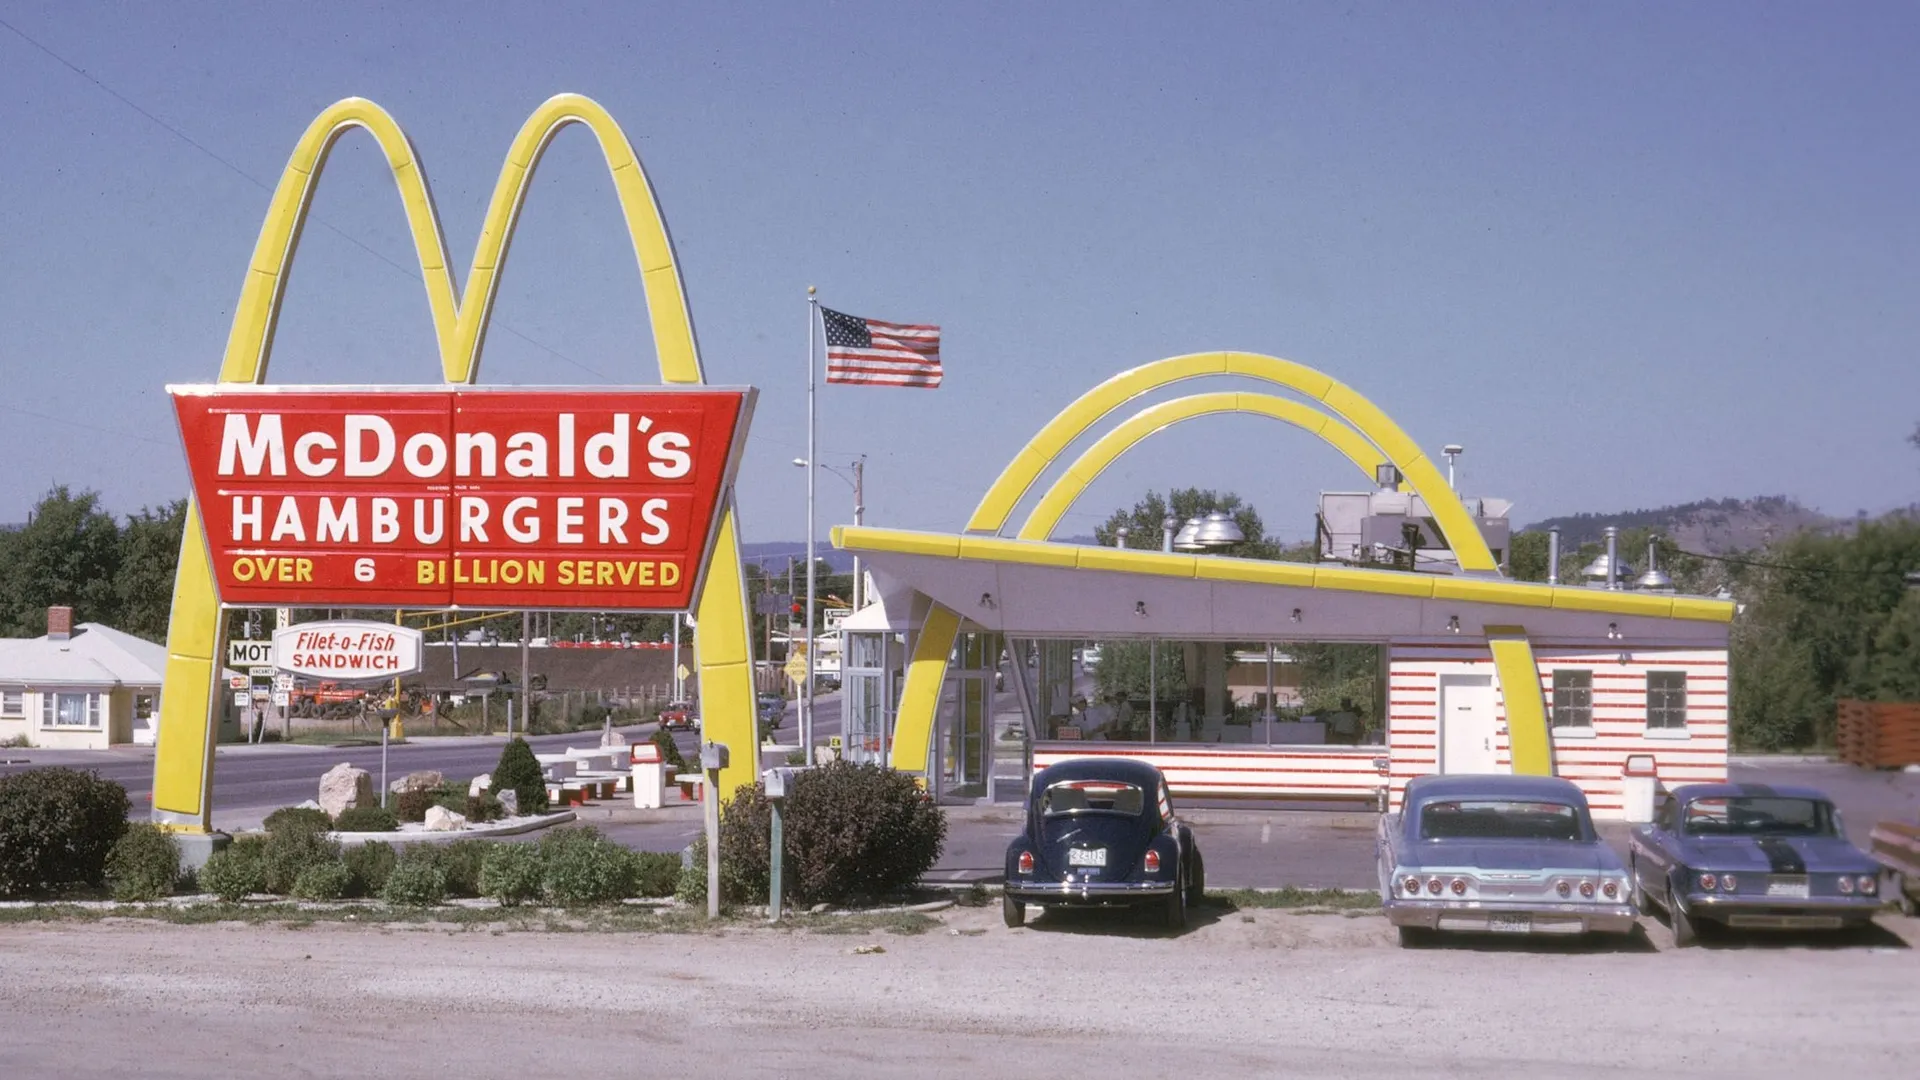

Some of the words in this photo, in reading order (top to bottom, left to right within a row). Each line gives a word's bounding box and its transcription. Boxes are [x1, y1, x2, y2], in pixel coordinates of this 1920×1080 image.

[217, 412, 692, 479] McDonald's
[231, 496, 670, 545] HAMBURGERS
[232, 557, 313, 582] OVER
[354, 557, 376, 582] 6
[417, 558, 545, 585] BILLION
[557, 560, 681, 587] SERVED
[296, 632, 395, 651] Filet-o-Fish
[293, 653, 399, 669] SANDWICH
